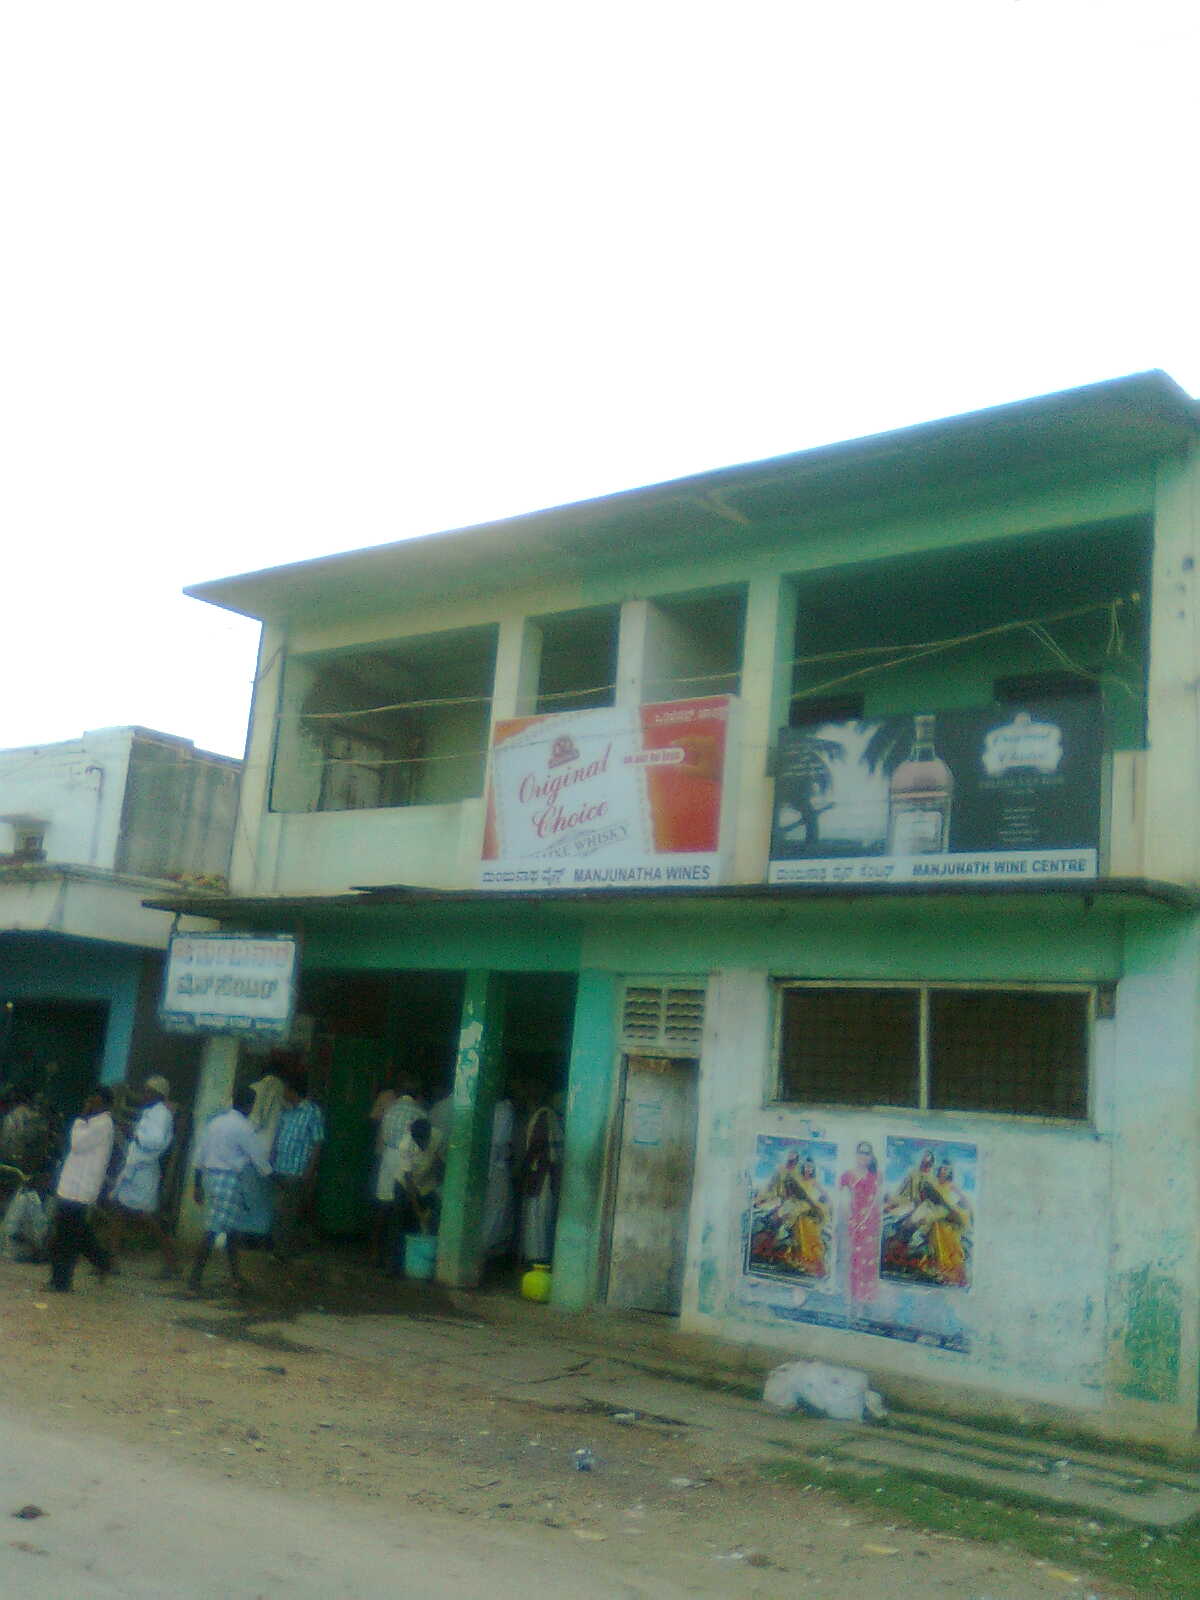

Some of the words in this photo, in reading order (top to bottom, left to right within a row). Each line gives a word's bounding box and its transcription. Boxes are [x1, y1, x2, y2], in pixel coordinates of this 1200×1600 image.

[519, 741, 613, 805] Original
[532, 801, 608, 838] Choice
[574, 866, 662, 883] MANJUNATHA
[665, 865, 711, 881] WINES
[912, 861, 990, 877] MANJUNATH
[994, 860, 1027, 875] WINE
[1032, 858, 1086, 874] CENTRE
